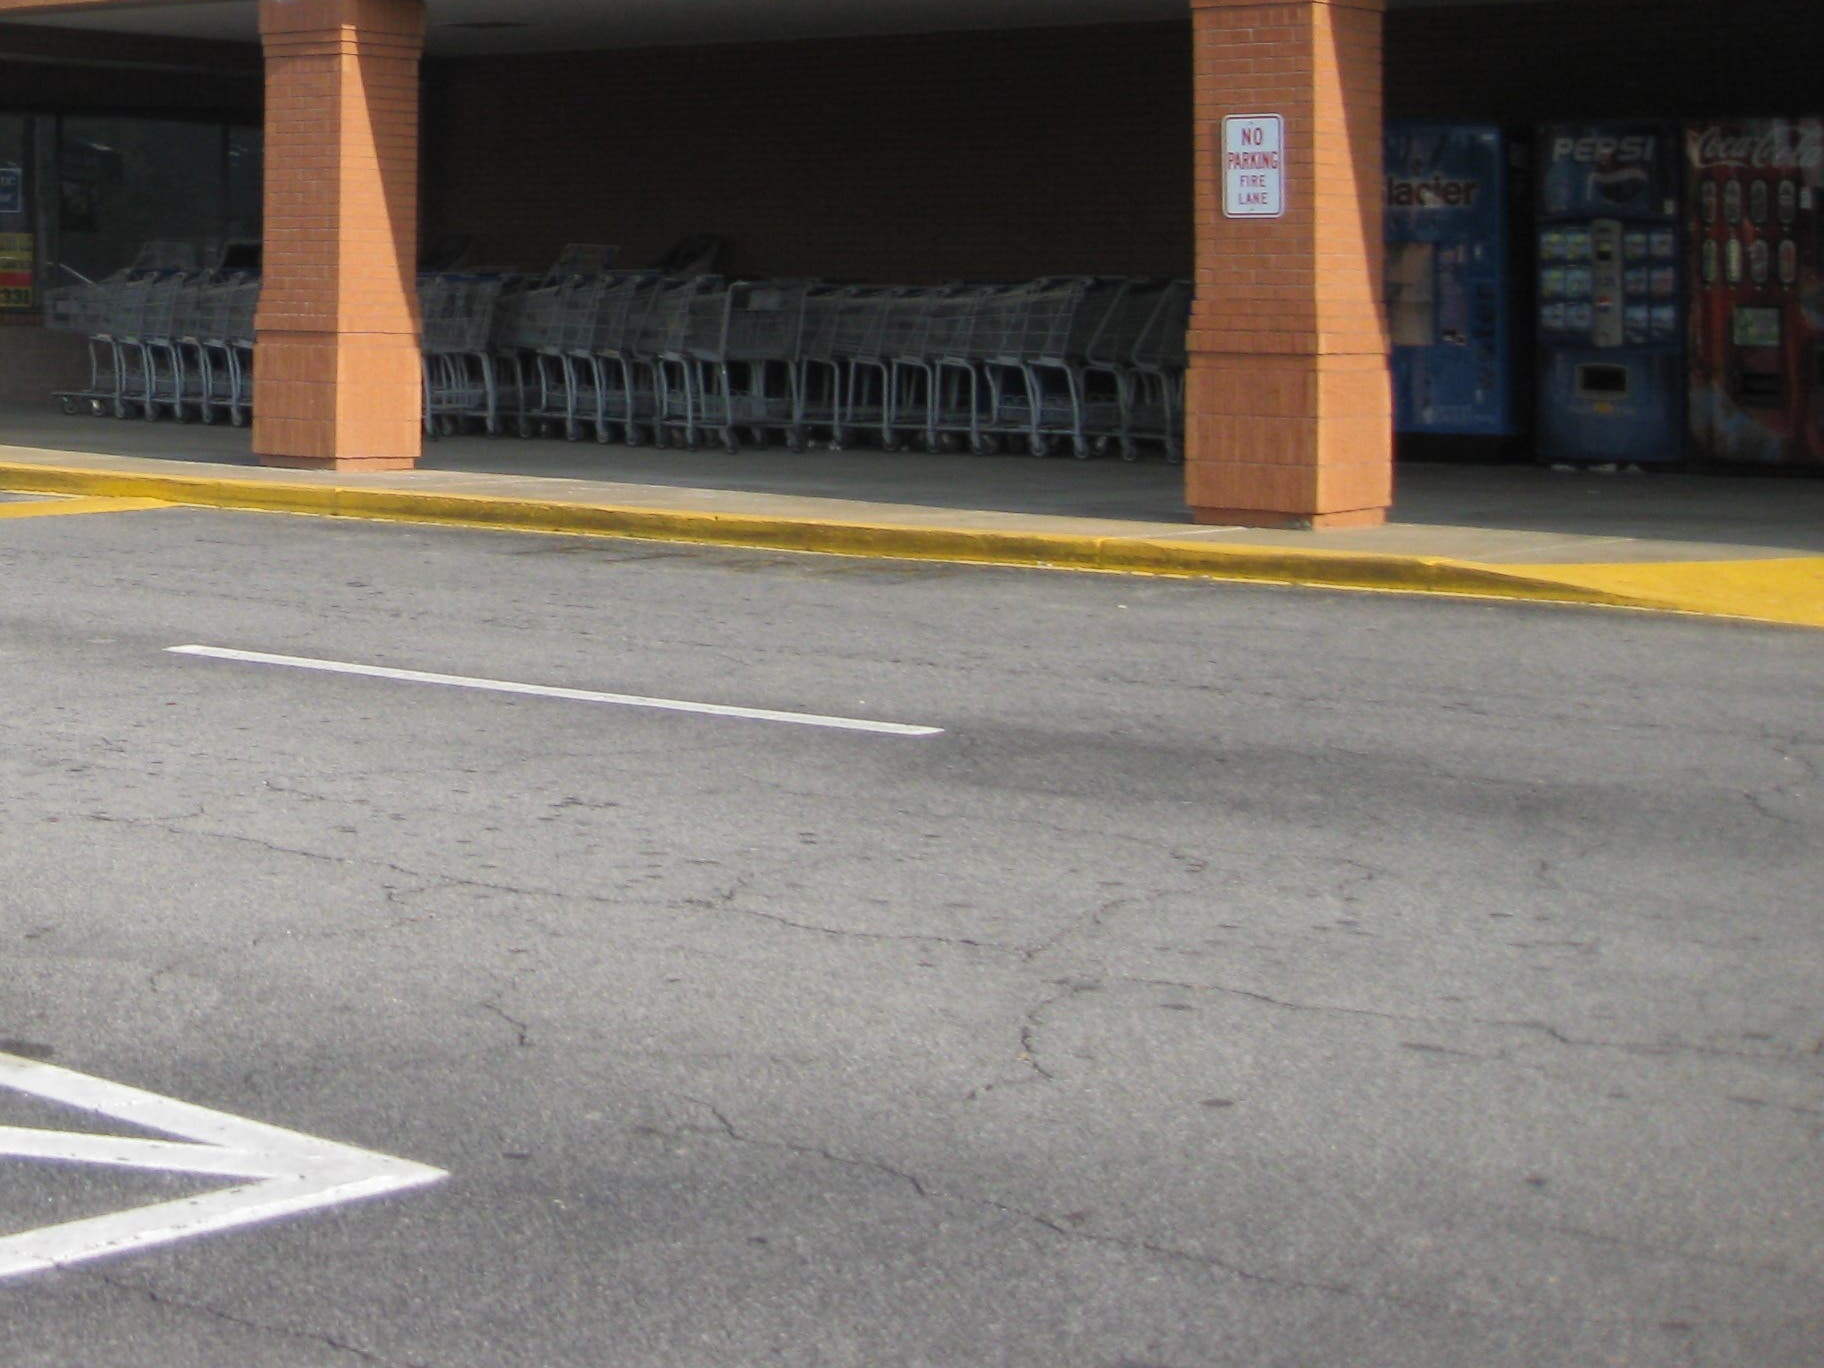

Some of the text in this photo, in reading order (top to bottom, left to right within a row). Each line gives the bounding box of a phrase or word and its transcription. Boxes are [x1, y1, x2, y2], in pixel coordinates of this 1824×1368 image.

[1241, 127, 1263, 146] NO
[1552, 135, 1656, 163] PEPSI
[1227, 151, 1279, 170] PARKING
[1239, 174, 1267, 187] FIRE
[1238, 192, 1268, 205] LANE
[1388, 175, 1478, 208] lacier
